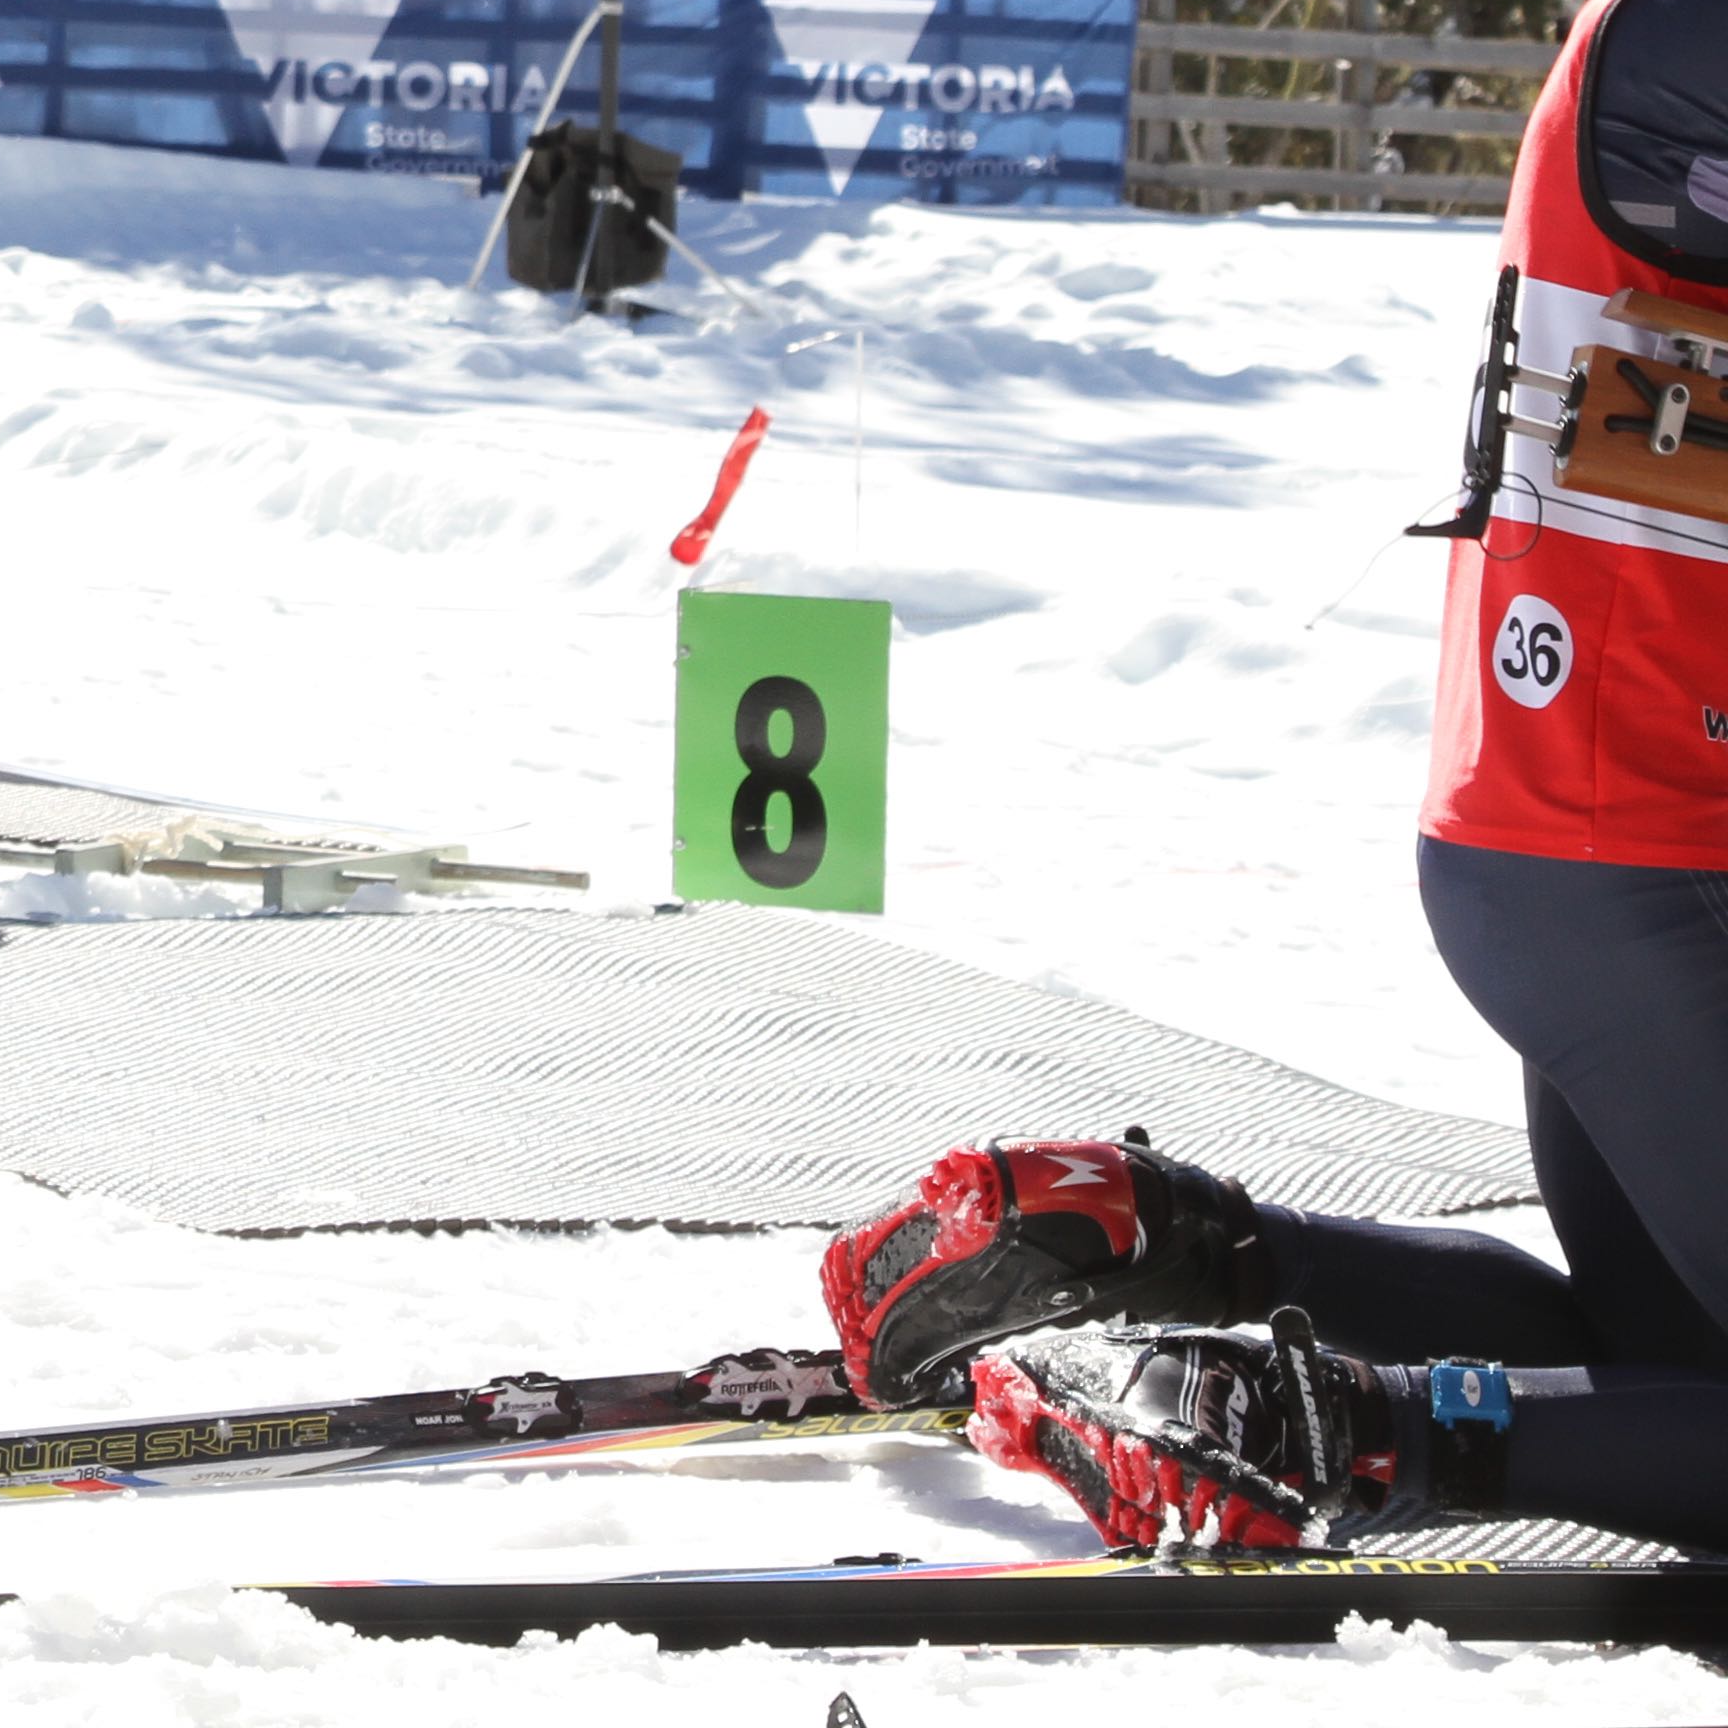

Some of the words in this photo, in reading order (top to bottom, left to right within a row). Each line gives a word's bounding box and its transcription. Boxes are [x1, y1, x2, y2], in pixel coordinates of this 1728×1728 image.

[246, 57, 550, 114] VICTORIA
[786, 61, 1075, 114] VICTORIA
[365, 121, 448, 151] State
[900, 123, 978, 152] State
[1500, 615, 1561, 686] 36
[730, 674, 828, 890] 8
[144, 1415, 331, 1462] SKATE
[760, 1408, 972, 1440] salomo
[1288, 1344, 1328, 1486] MADSHUS
[75, 1465, 108, 1481] 186
